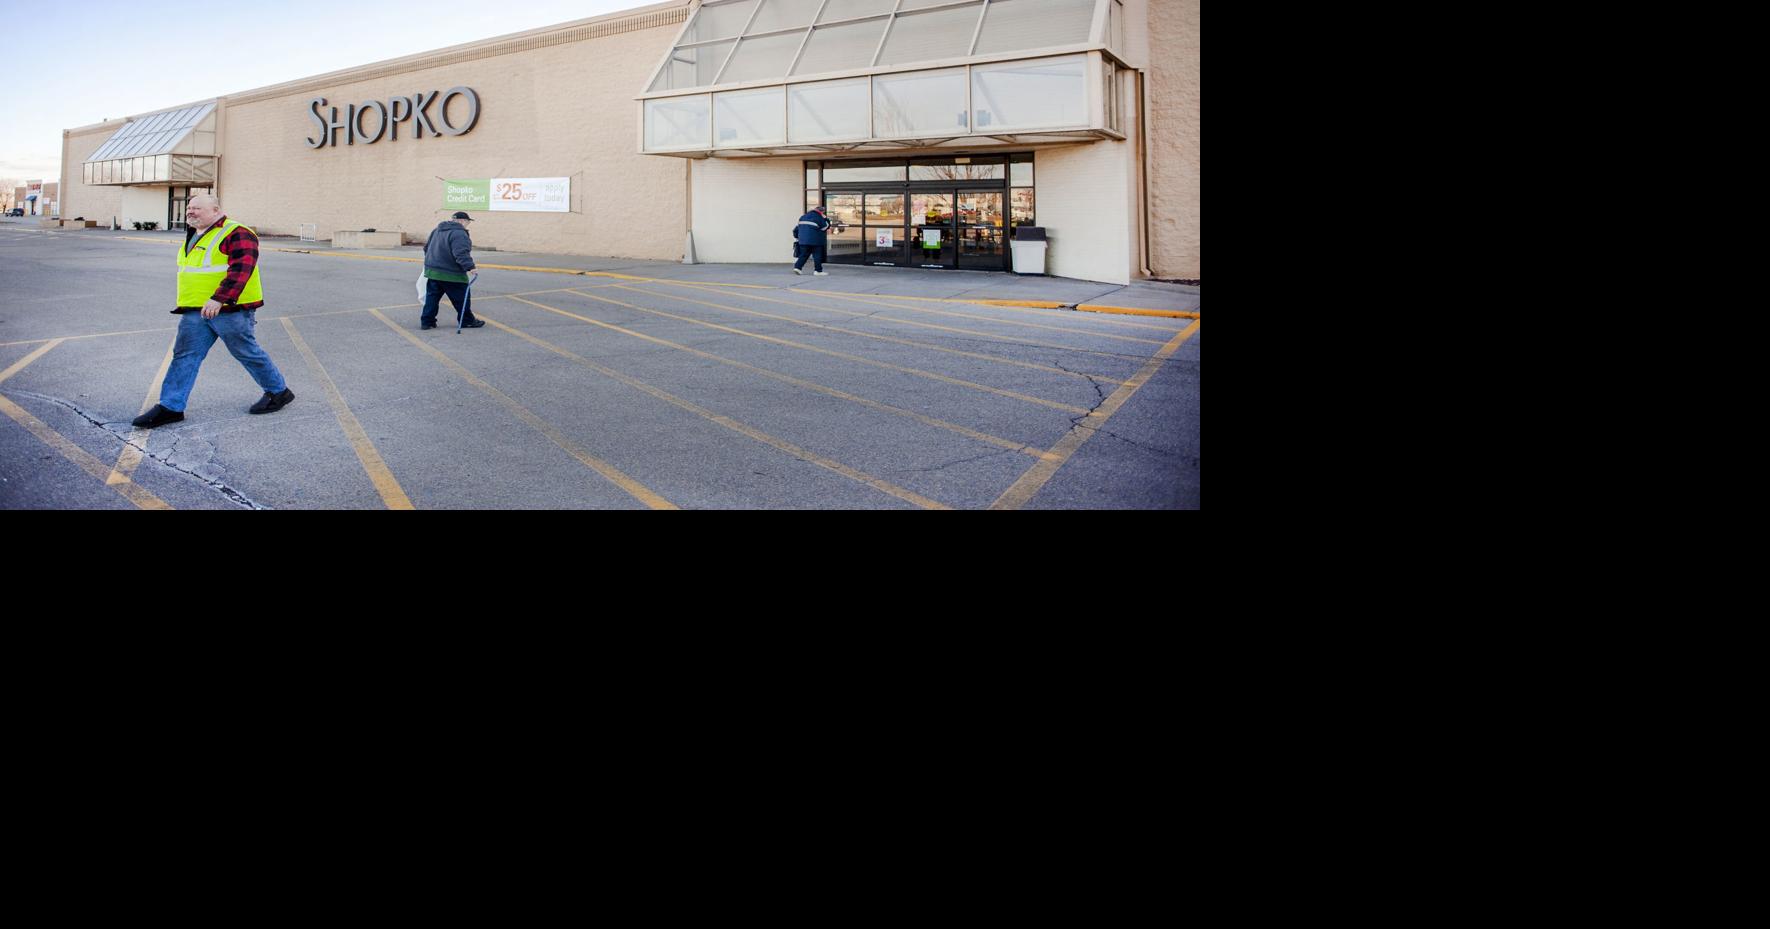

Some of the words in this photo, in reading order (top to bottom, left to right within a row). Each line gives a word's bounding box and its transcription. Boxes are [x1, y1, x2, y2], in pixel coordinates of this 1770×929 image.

[306, 86, 481, 149] SHOPKO
[447, 185, 474, 195] Shopko
[447, 194, 467, 203] Credit
[468, 194, 486, 203] Card
[522, 192, 537, 200] OFF
